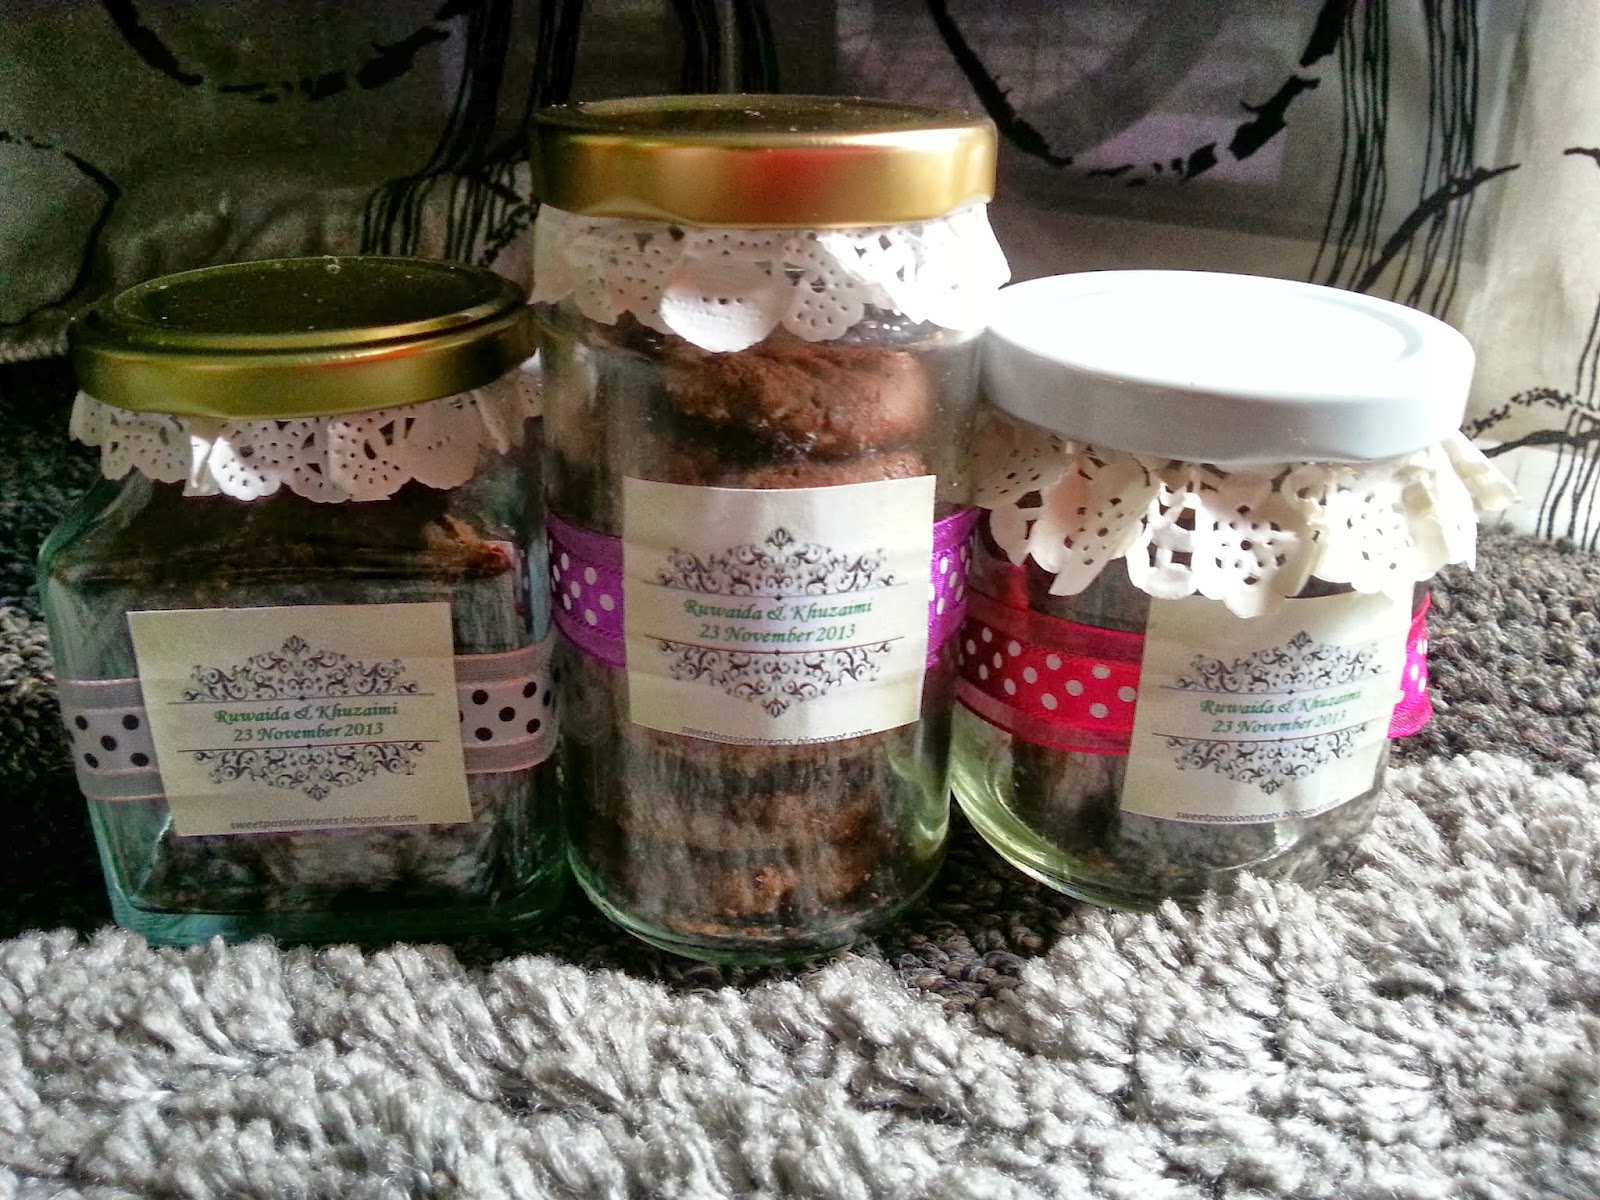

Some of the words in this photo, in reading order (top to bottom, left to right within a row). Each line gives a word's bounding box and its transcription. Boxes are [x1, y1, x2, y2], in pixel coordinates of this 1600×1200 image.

[683, 599, 762, 622] Ruwaida
[767, 608, 786, 621] &
[791, 599, 872, 622] Khuzaimi
[699, 623, 719, 640] 23
[724, 624, 813, 643] November
[815, 623, 856, 642] 2013
[214, 706, 290, 725] Ruwaida
[293, 708, 312, 721] &
[315, 702, 398, 722] Khuzaimi
[1200, 699, 1275, 716] Ruwaida
[1278, 700, 1294, 713] &
[234, 728, 253, 743] 23
[257, 725, 342, 742] November
[344, 721, 384, 737] 2013
[1212, 719, 1232, 734] 23
[1235, 718, 1313, 734] November
[1314, 710, 1346, 729] 2013
[230, 813, 419, 830] sweetpassiontreats.blogspot.com
